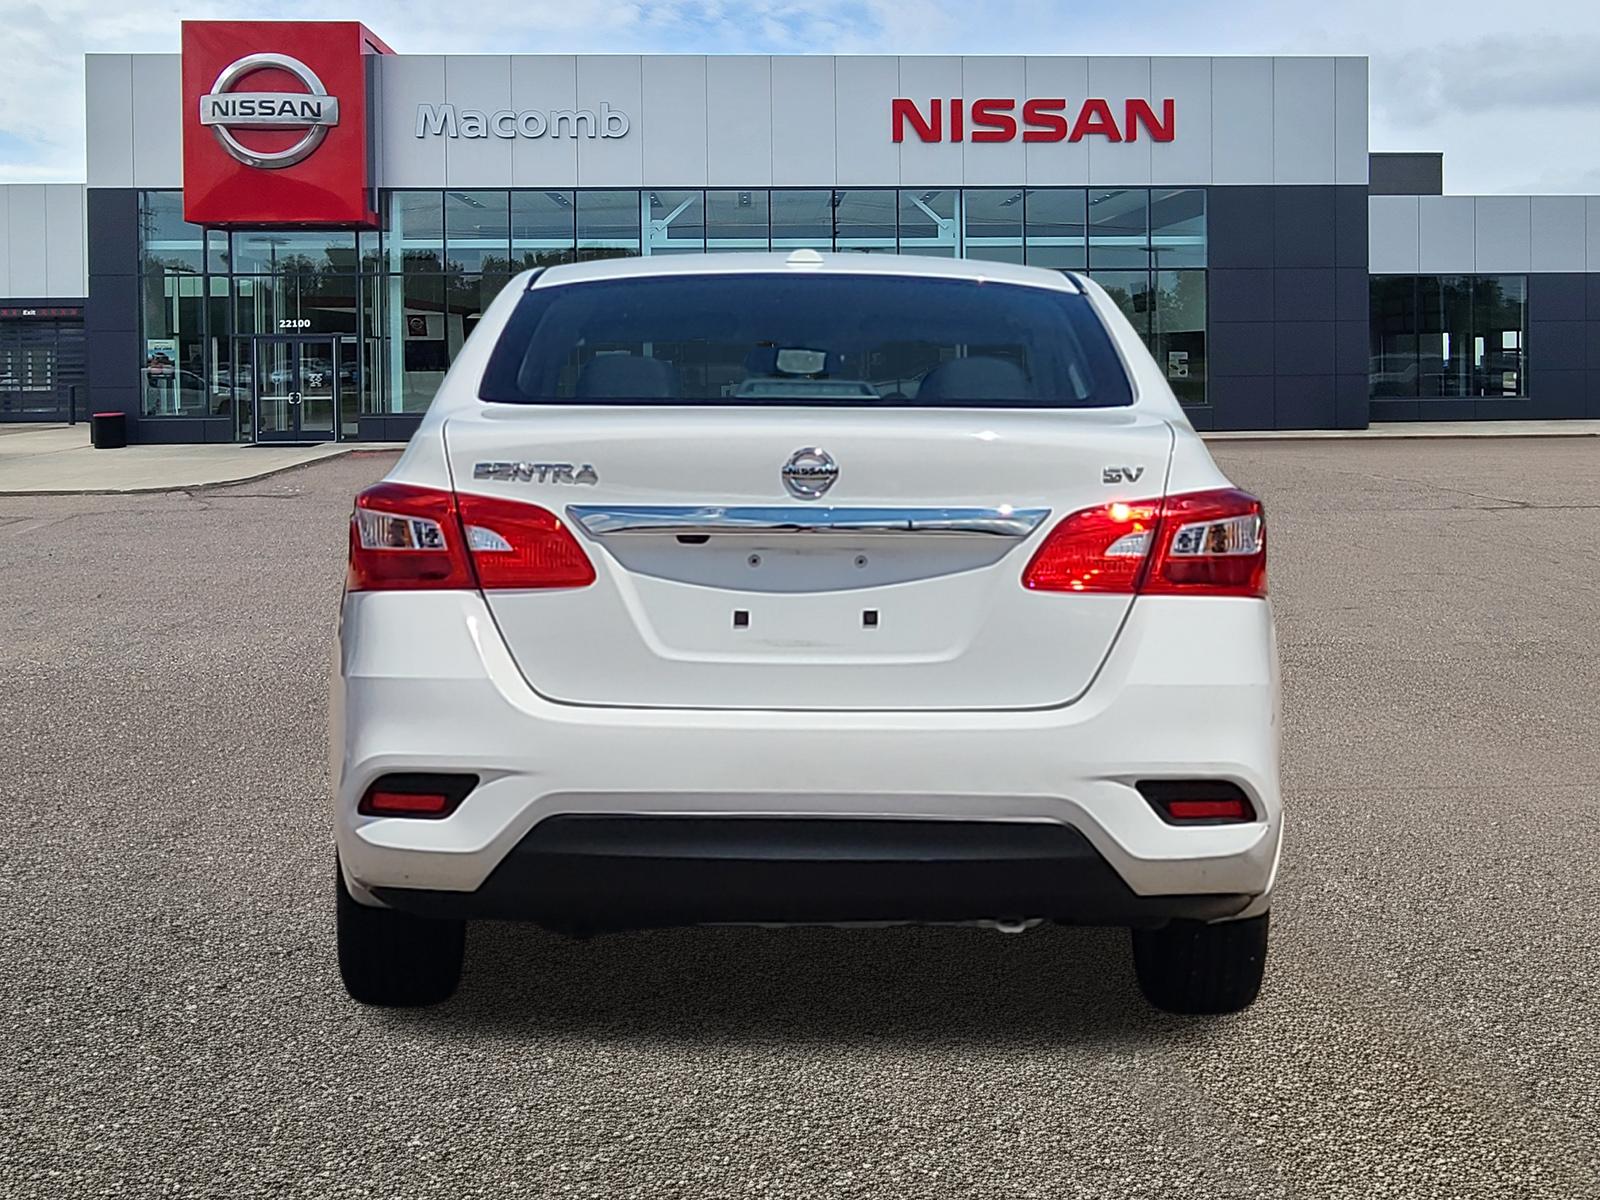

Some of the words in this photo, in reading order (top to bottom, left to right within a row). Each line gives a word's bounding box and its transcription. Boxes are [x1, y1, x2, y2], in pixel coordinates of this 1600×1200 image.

[211, 100, 322, 118] NISSAN
[415, 102, 630, 139] Macomb
[892, 98, 1175, 143] NISSAN
[279, 319, 311, 328] 22100
[473, 462, 599, 486] SENTRA
[1103, 467, 1144, 483] SV
